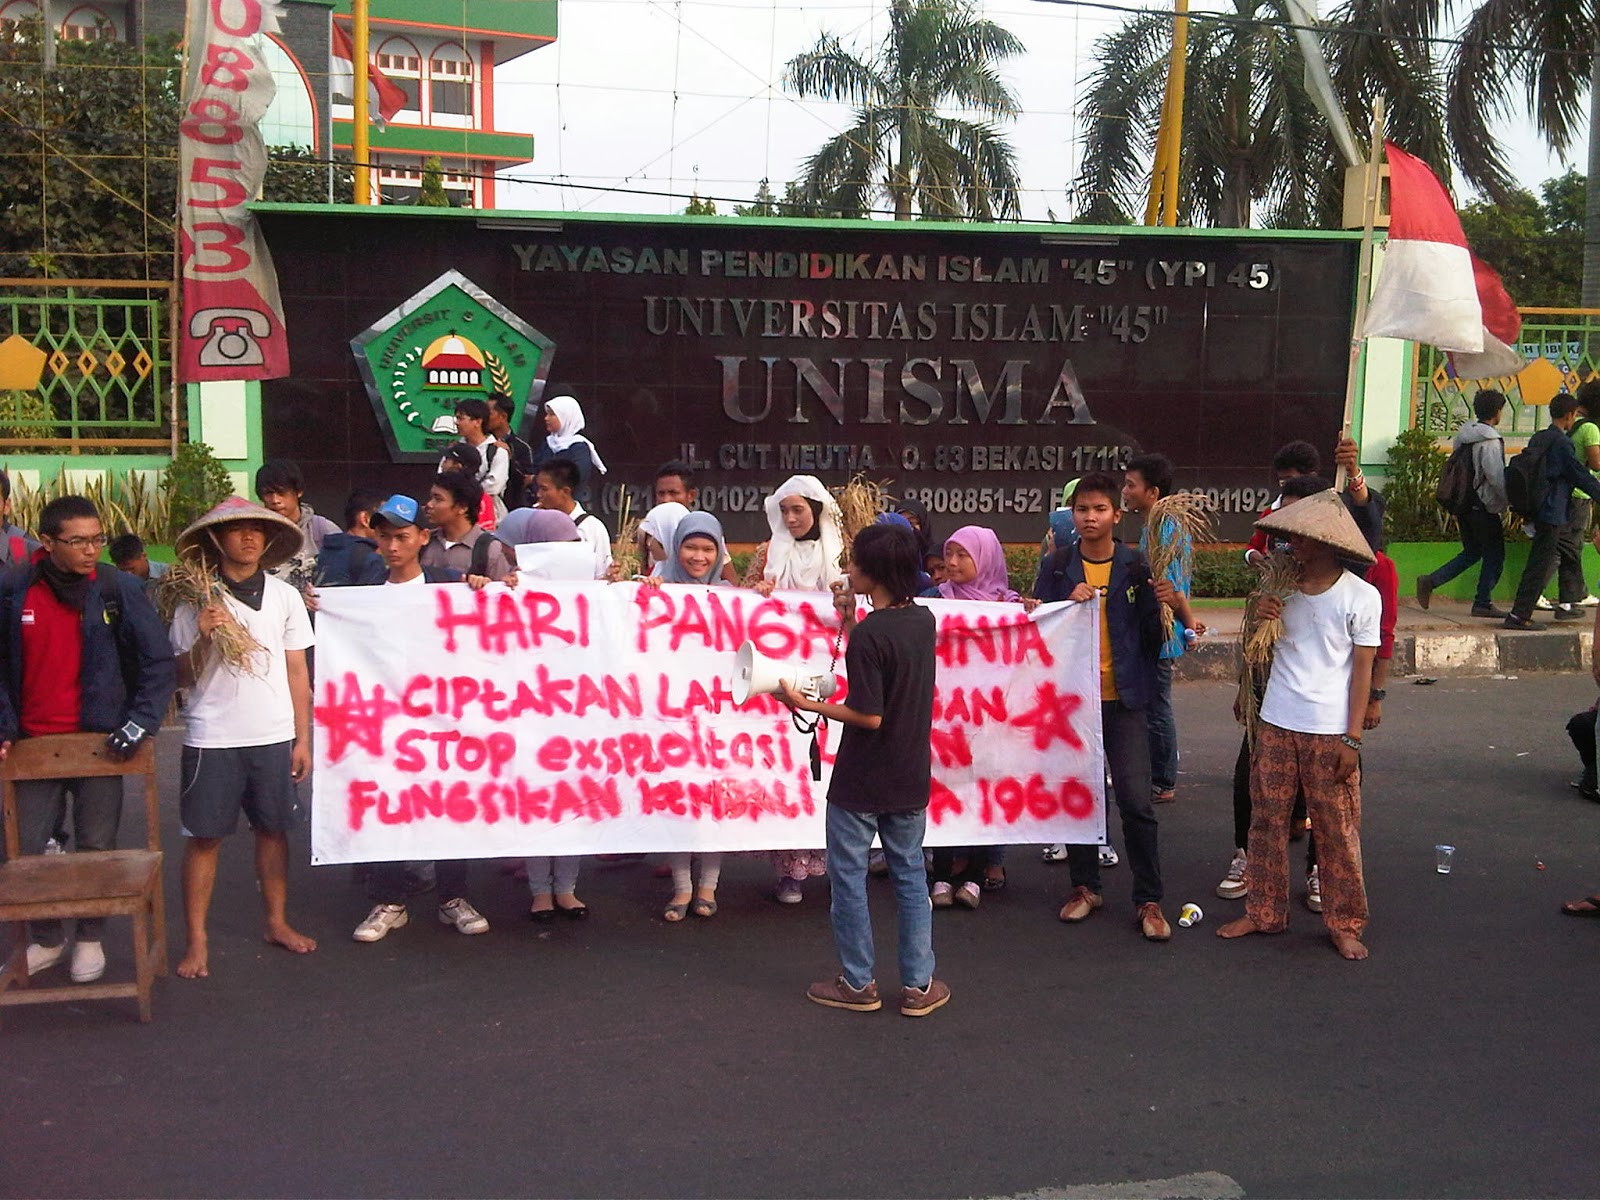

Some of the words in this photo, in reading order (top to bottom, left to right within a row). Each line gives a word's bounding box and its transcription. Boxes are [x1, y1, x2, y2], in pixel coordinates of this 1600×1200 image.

[512, 244, 689, 275] YAYASAN
[701, 249, 926, 282] PENDIDIKAN
[937, 256, 1050, 283] ISLAM
[1061, 258, 1134, 285] "45"
[1145, 258, 1216, 290] (YPI
[1226, 261, 1281, 291] 45)
[643, 296, 937, 341] UNIVERSITAS
[952, 303, 1086, 342] ISLAM
[1100, 305, 1168, 343] "45"
[714, 355, 1097, 426] UNISMA
[719, 444, 771, 470] CUT
[780, 445, 875, 470] MEUTIA
[934, 446, 966, 471] 83
[972, 446, 1064, 471] BEKASI
[1072, 446, 1134, 471] 17113
[435, 587, 589, 654] HARI
[394, 729, 517, 777] STOP
[977, 772, 1095, 826] 1960
